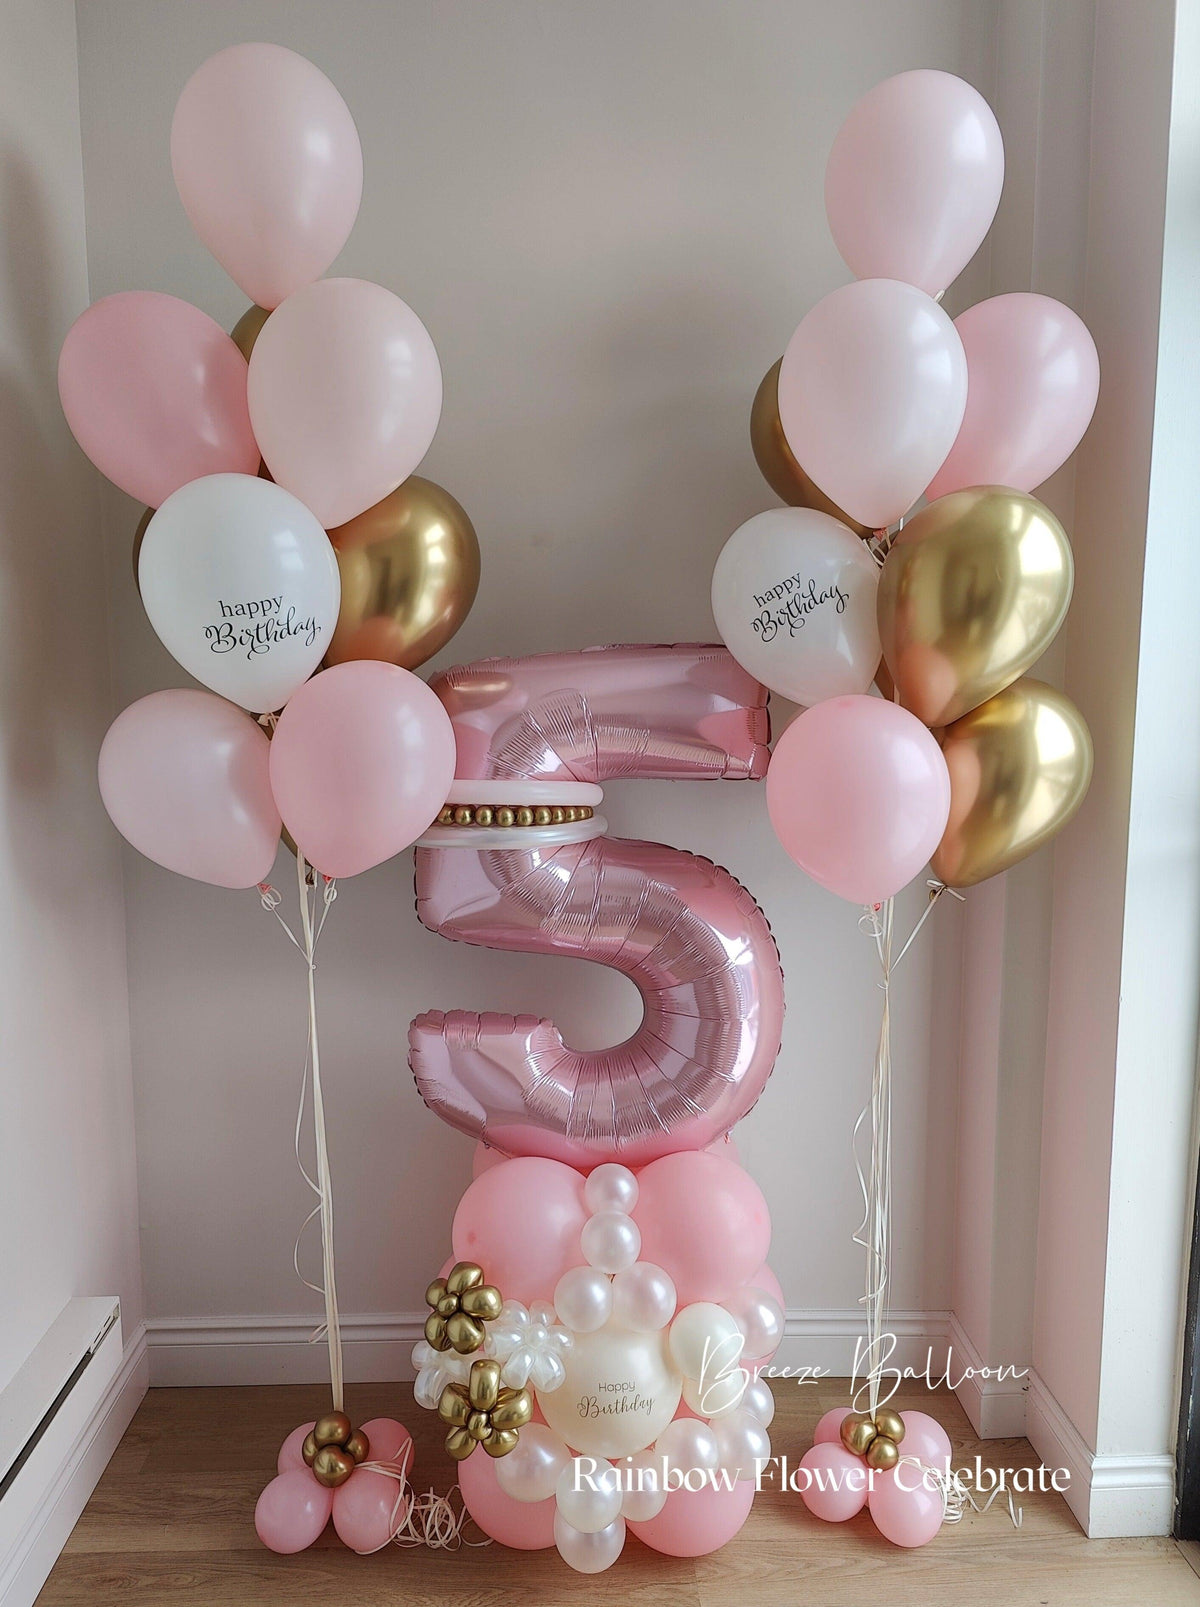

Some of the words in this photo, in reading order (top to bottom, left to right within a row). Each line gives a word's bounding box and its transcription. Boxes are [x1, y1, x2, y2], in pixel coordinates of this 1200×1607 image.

[753, 572, 800, 608] happy
[218, 595, 283, 619] happy
[750, 579, 849, 642] Birthday
[202, 605, 321, 660] Birthday
[598, 1381, 636, 1394] Happy
[576, 1394, 656, 1418] Birthday
